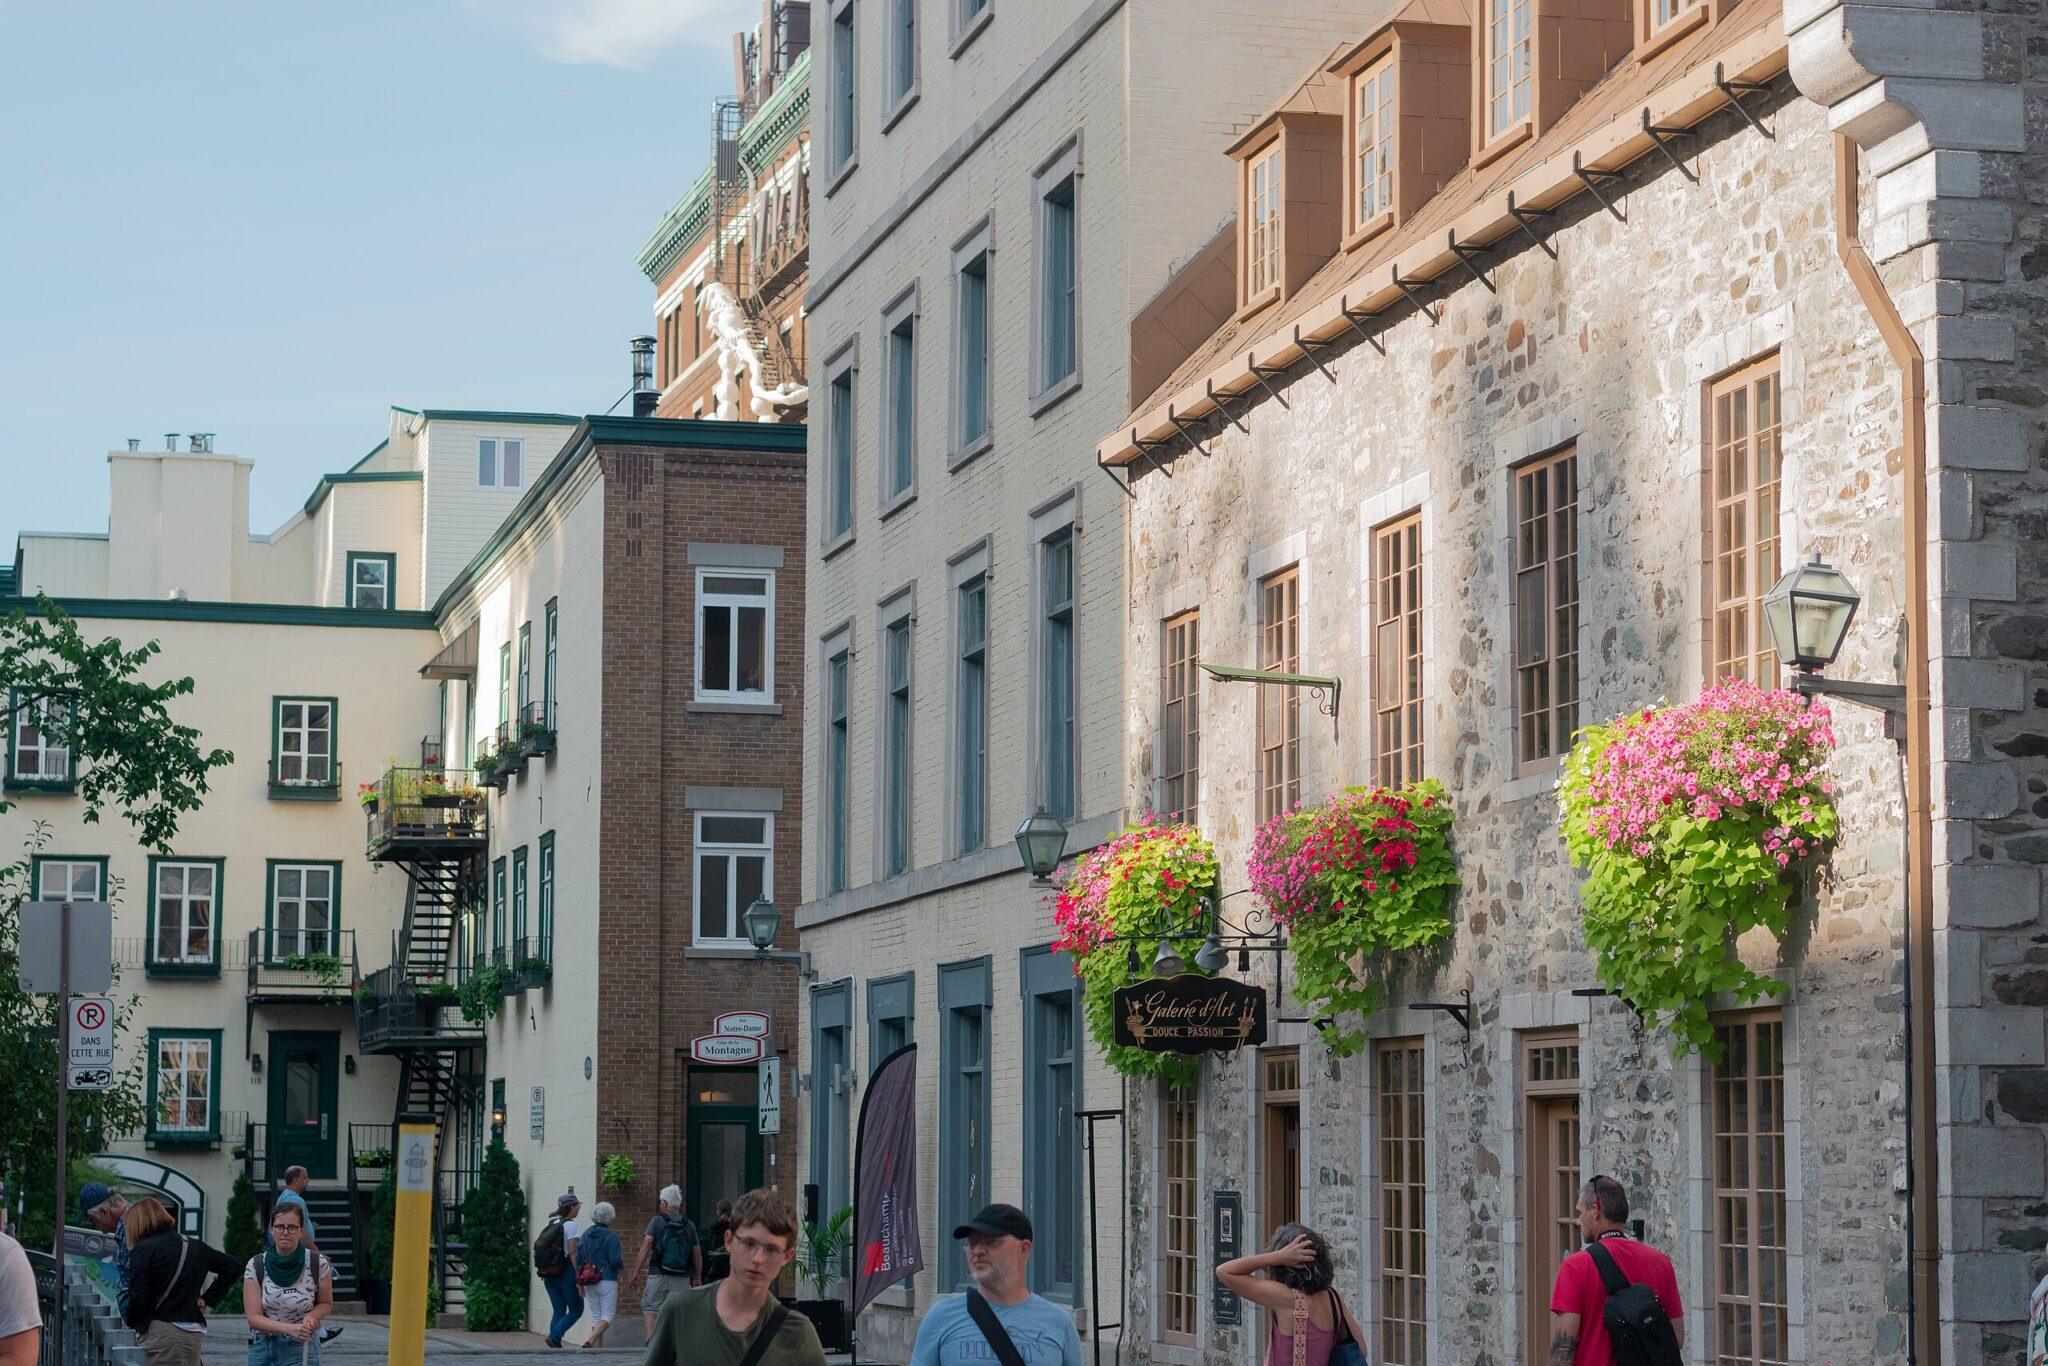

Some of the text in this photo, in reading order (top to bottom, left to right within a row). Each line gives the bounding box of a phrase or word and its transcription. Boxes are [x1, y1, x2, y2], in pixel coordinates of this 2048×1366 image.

[1144, 991, 1197, 1025] Galerie
[724, 1024, 762, 1032] Notre-Dame
[1152, 1027, 1224, 1037] DOUCE PASSION
[81, 1037, 101, 1046] DANS
[71, 1049, 111, 1057] CETTE RUE
[705, 1046, 752, 1056] Montagne
[881, 1191, 891, 1271] Beauchamp
[960, 1340, 1033, 1363] PUA
